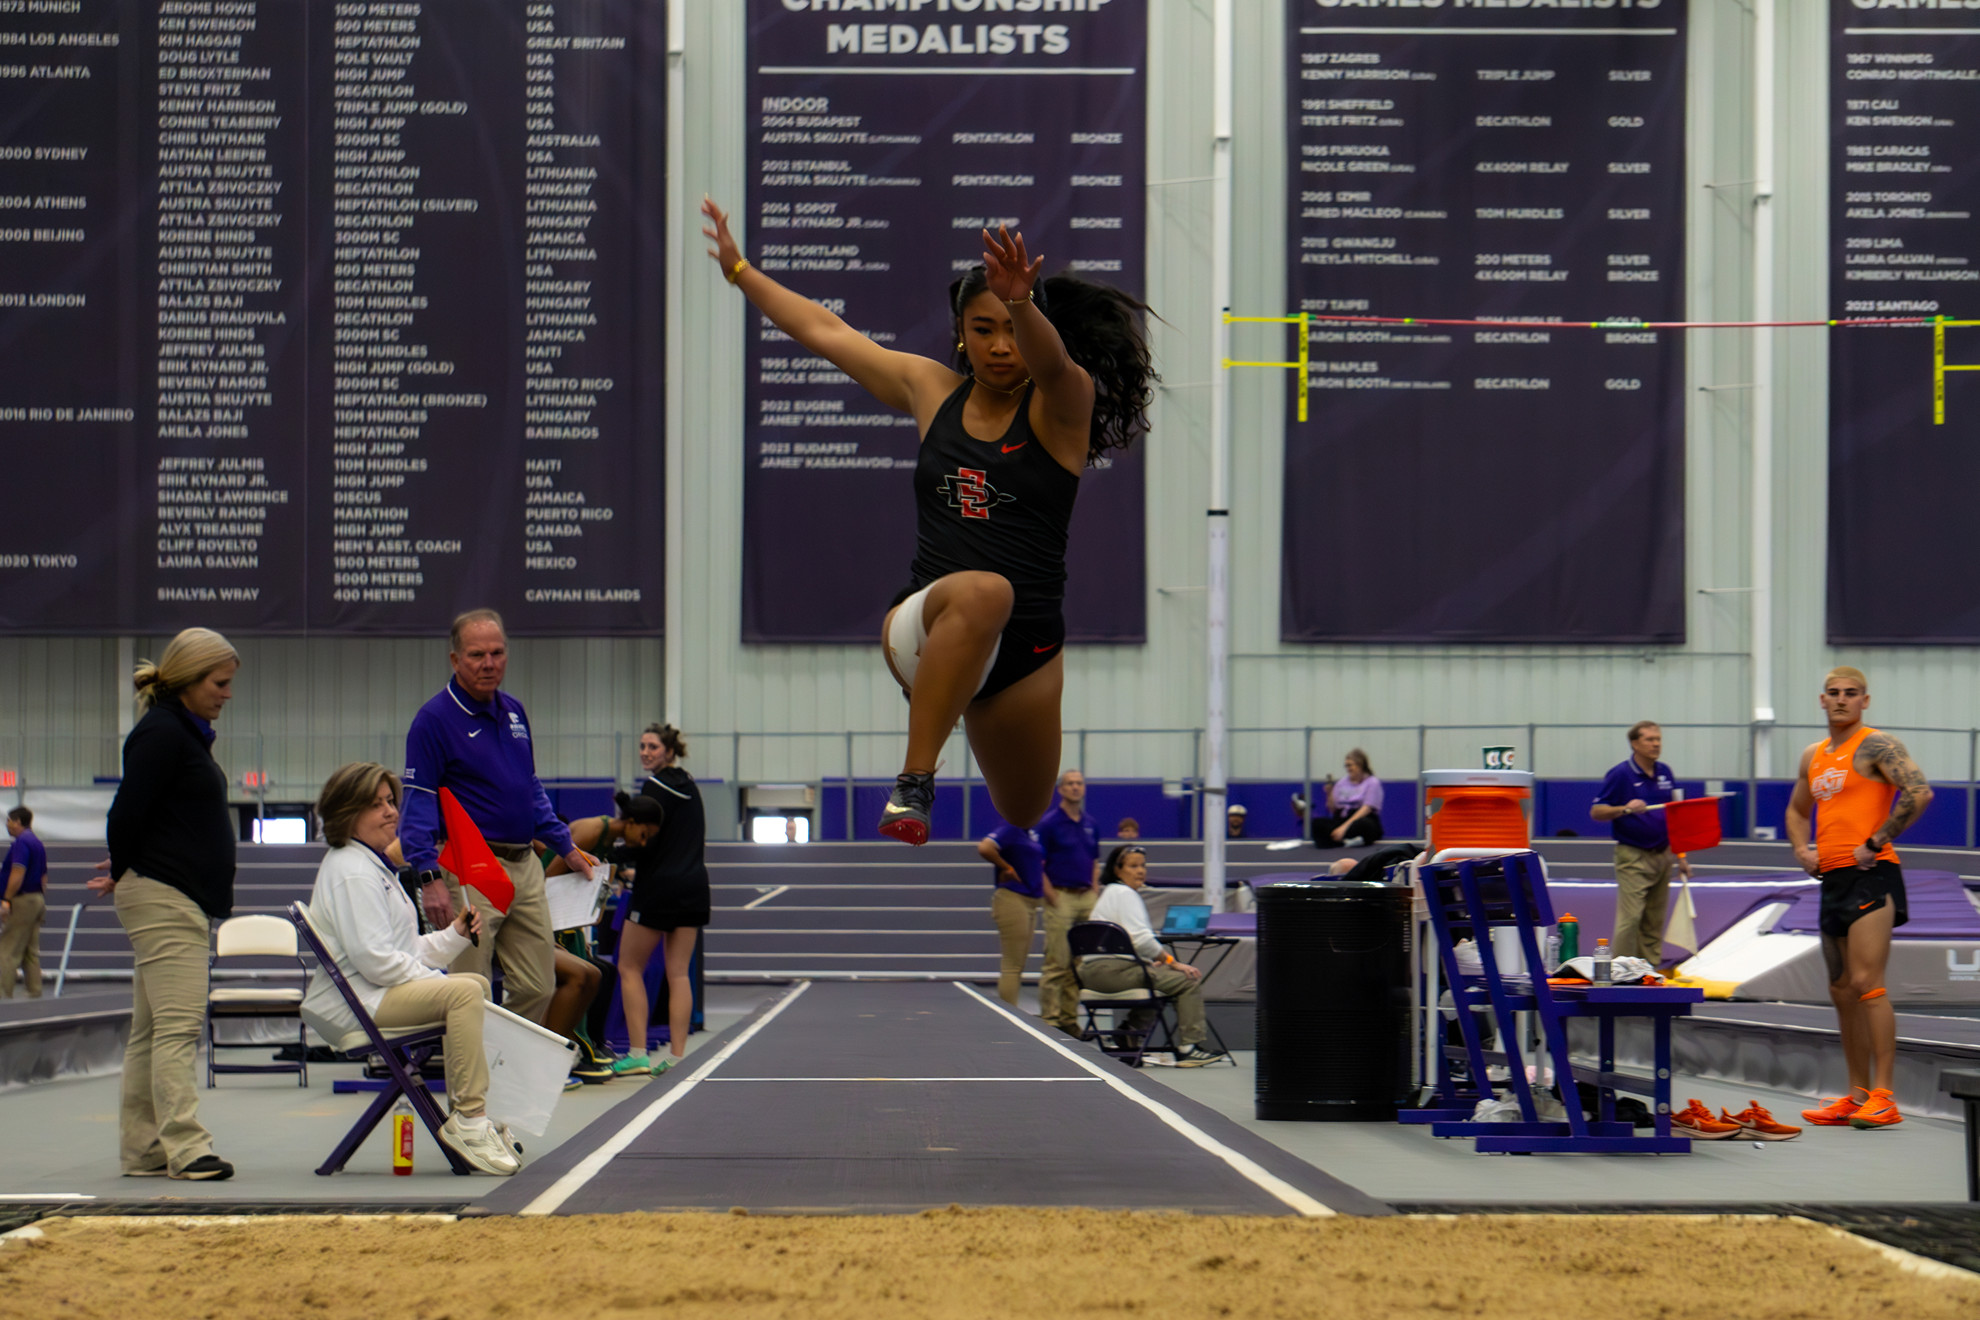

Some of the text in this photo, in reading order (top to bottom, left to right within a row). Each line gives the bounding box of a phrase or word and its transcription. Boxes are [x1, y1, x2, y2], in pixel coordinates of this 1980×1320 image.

[29, 1, 80, 12] MUNICH
[335, 4, 421, 15] 1500 METERS
[30, 34, 55, 45] LOS
[59, 34, 119, 45] ANGELES
[526, 37, 625, 48] GREAT BRITAIN
[827, 25, 1069, 53] MEDALISTS
[335, 53, 413, 64] POLE VAULT
[31, 66, 90, 77] ATLANTA
[335, 85, 414, 97] DECATHLON
[526, 86, 554, 97] USA
[335, 102, 467, 113] TRIPLE JUMP (GOLD)
[762, 97, 828, 112] INDOOR
[527, 135, 600, 146] AUSTRALIA
[35, 148, 87, 159] SYDNEY
[526, 168, 597, 178] LITHUANIA
[526, 184, 591, 195] HUNGARY
[35, 197, 86, 208] ATHENS
[335, 199, 478, 211] HEPTATHLON (SILVER)
[34, 229, 84, 241] BEIJING
[526, 233, 586, 243] JAMAICA
[30, 294, 85, 306] LONDON
[335, 297, 428, 308] 110M HURDLES
[526, 346, 562, 357] HAITI
[526, 378, 613, 390] PUERTO RICO
[334, 394, 487, 406] HEPTATHLON (BRONZE)
[30, 409, 52, 420] RIO
[56, 409, 73, 420] DE
[78, 409, 134, 420] JANEIRO
[526, 427, 599, 438] BARBADOS
[334, 492, 381, 503] DISCUS
[334, 508, 408, 519] MARATHON
[526, 525, 582, 536] CANADA
[334, 540, 461, 552] MEN'S ASST. COACH
[34, 555, 77, 567] TOKYO
[526, 557, 577, 568] MEXICO
[334, 589, 415, 601] 400 METERS
[526, 590, 640, 601] CAYMAN ISLANDS
